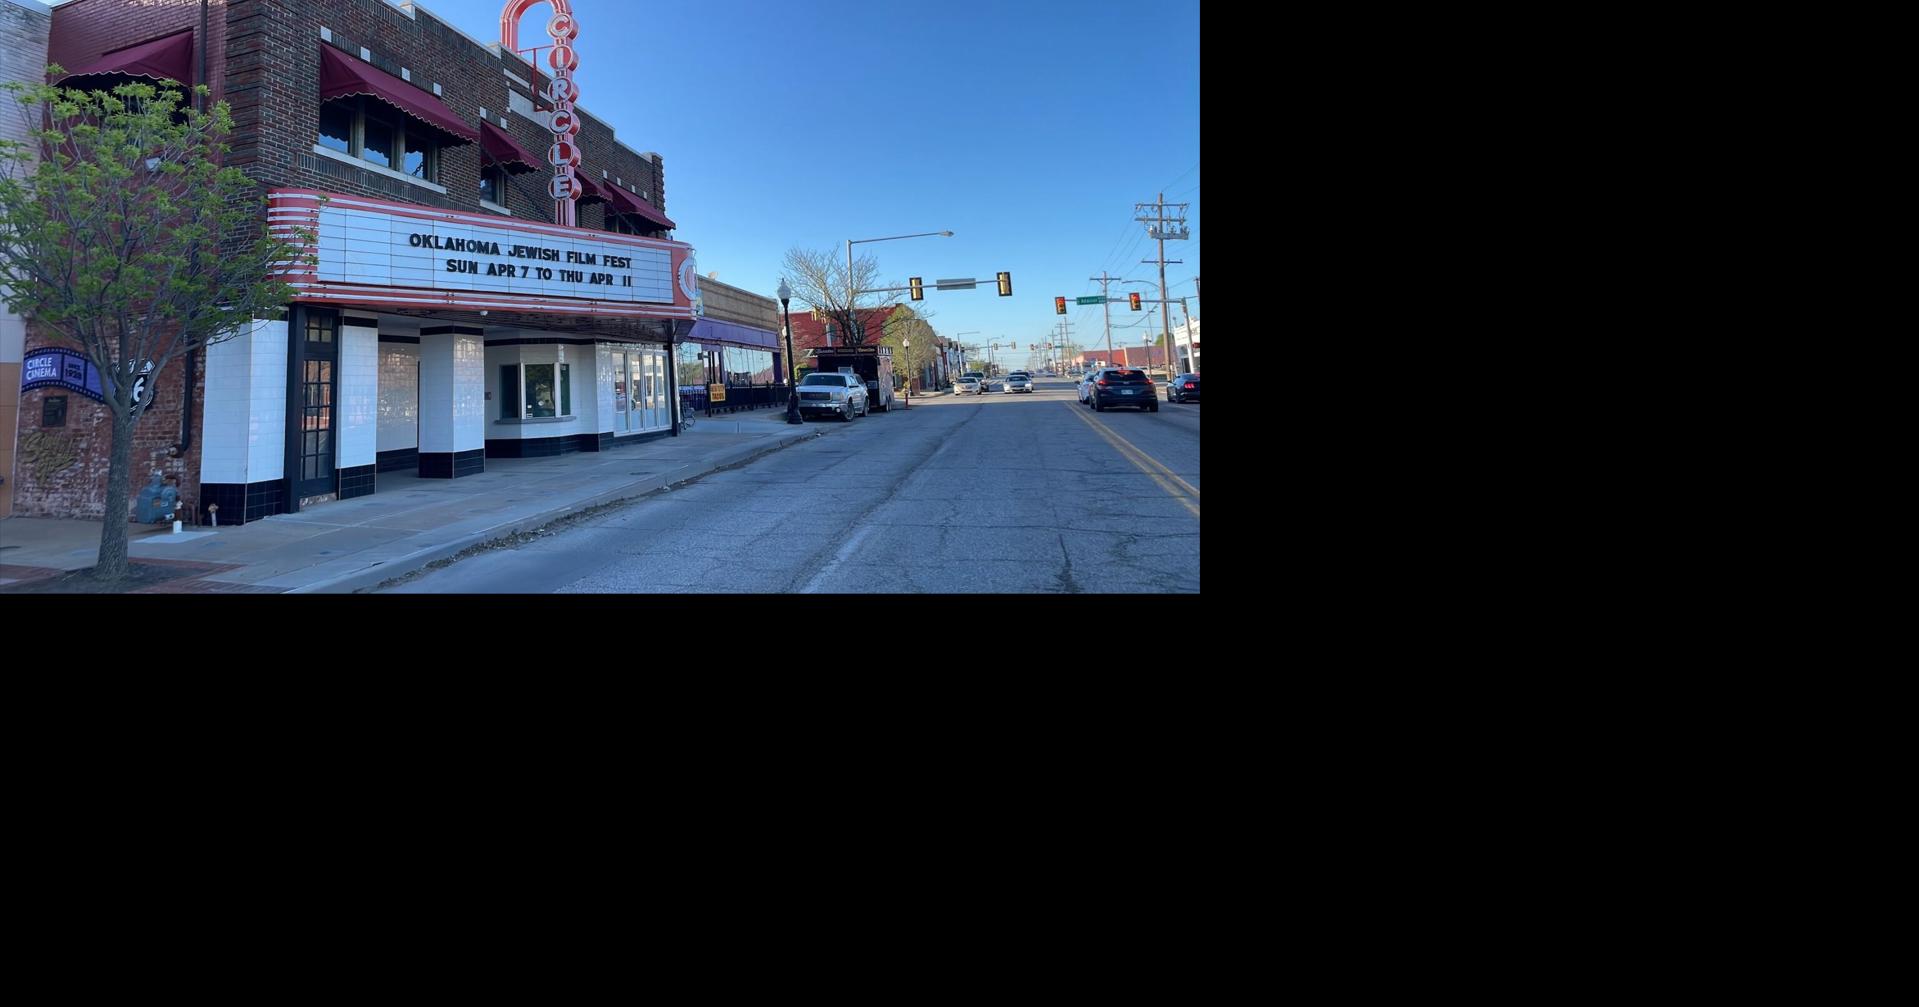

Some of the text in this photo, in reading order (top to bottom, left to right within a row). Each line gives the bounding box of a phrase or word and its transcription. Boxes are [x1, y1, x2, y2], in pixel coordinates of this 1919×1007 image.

[550, 14, 572, 198] CIRCLE
[409, 233, 631, 268] OKLAHOMA JEWISH FILM FEST
[447, 259, 631, 287] SUN APR 7 TO THU APR 11
[26, 367, 57, 380] CINEMA
[27, 357, 52, 369] CIRCLE
